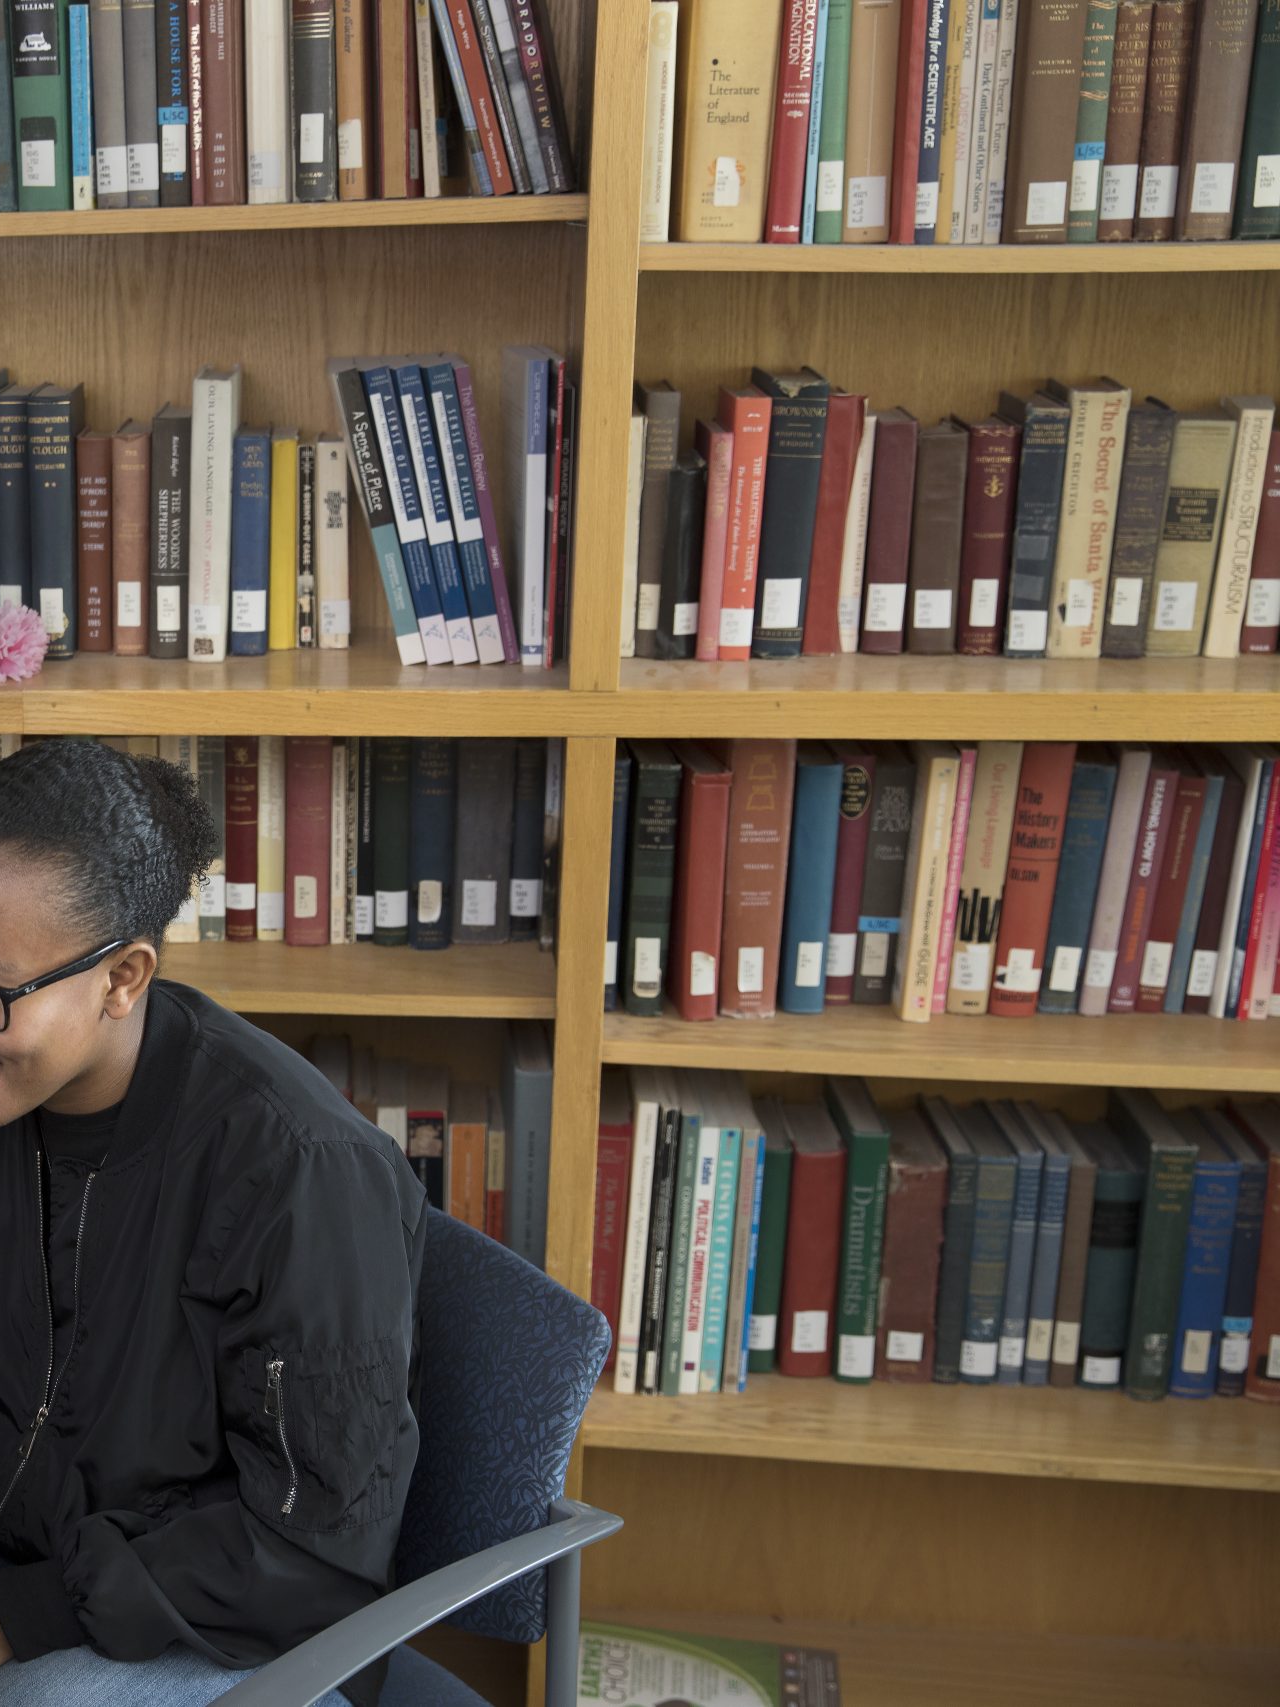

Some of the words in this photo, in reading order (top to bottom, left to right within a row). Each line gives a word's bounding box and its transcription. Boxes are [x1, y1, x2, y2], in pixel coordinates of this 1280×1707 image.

[15, 3, 55, 11] WILLIAMS
[169, 2, 179, 12] A
[209, 4, 217, 33] CHAUCER
[169, 15, 181, 64] HOUSE
[190, 23, 200, 44] The
[455, 9, 466, 29] High
[462, 31, 472, 50] Wire
[799, 0, 816, 81] EDUCATIONAL
[191, 46, 201, 78] LAST
[710, 69, 732, 82] The
[982, 63, 993, 86] Dark
[171, 68, 181, 97] FOR
[191, 79, 201, 88] of
[192, 89, 202, 108] the
[528, 60, 551, 129] REVIEW
[709, 83, 760, 96] Literature
[924, 63, 939, 125] SCIENTIFIC
[707, 99, 719, 110] of
[707, 111, 750, 125] England
[978, 88, 991, 133] Continent
[478, 97, 491, 130] Number
[486, 130, 503, 178] Twenty-Five
[656, 132, 664, 163] COLLEGE
[923, 126, 935, 149] AGE
[977, 135, 986, 152] and
[1077, 144, 1103, 159] L/SC
[975, 154, 986, 180] Other
[972, 182, 983, 214] Stories
[207, 384, 216, 408] OUR
[383, 394, 392, 402] A
[460, 385, 473, 407] The
[773, 406, 827, 418] BROWNING
[352, 411, 365, 421] A
[385, 410, 403, 446] SENSE
[417, 410, 431, 445] SENSE
[446, 408, 461, 444] SENSE
[464, 408, 481, 454] Missouri
[1074, 398, 1089, 448] ROBERT
[1100, 398, 1122, 432] The
[206, 412, 216, 451] LIVING
[355, 421, 372, 459] Sense
[32, 445, 68, 455] CLOUGH
[396, 454, 408, 468] OF
[425, 455, 436, 470] OF
[455, 454, 467, 471] OF
[752, 455, 763, 477] THE
[1094, 436, 1117, 494] Secret
[1245, 416, 1268, 486] Introduction
[364, 463, 379, 474] of
[472, 453, 487, 492] Review
[1067, 452, 1083, 517] CRICHTON
[171, 488, 182, 513] THE
[205, 455, 214, 516] LANGUAGE
[367, 477, 383, 511] Place
[400, 477, 417, 513] PLACE
[429, 478, 447, 515] PLACE
[459, 477, 475, 514] PLACE
[1241, 489, 1255, 503] to
[303, 492, 311, 541] BURNT-OUT
[747, 480, 762, 541] DIALECTICAL
[1093, 499, 1108, 517] of
[158, 488, 169, 570] SHEPHERDESS
[170, 518, 181, 570] WOODEN
[303, 543, 311, 565] CASE
[743, 543, 756, 581] TEMPER
[1085, 521, 1108, 574] Santa
[1224, 505, 1256, 615] STRUCTURALISM
[992, 762, 1008, 784] Our
[985, 784, 1004, 818] Living
[1022, 787, 1044, 806] The
[1145, 777, 1168, 831] READING,
[1017, 810, 1060, 831] History
[979, 818, 1000, 870] Language
[1014, 832, 1058, 850] Makers
[1142, 831, 1158, 861] HOW
[1008, 868, 1040, 882] OLSON
[1138, 861, 1152, 878] TO
[915, 948, 931, 987] GUIDE
[694, 1199, 710, 1247] POLITICAL
[842, 1184, 874, 1317] Dramatists
[687, 1249, 705, 1332] COMMUNICATION
